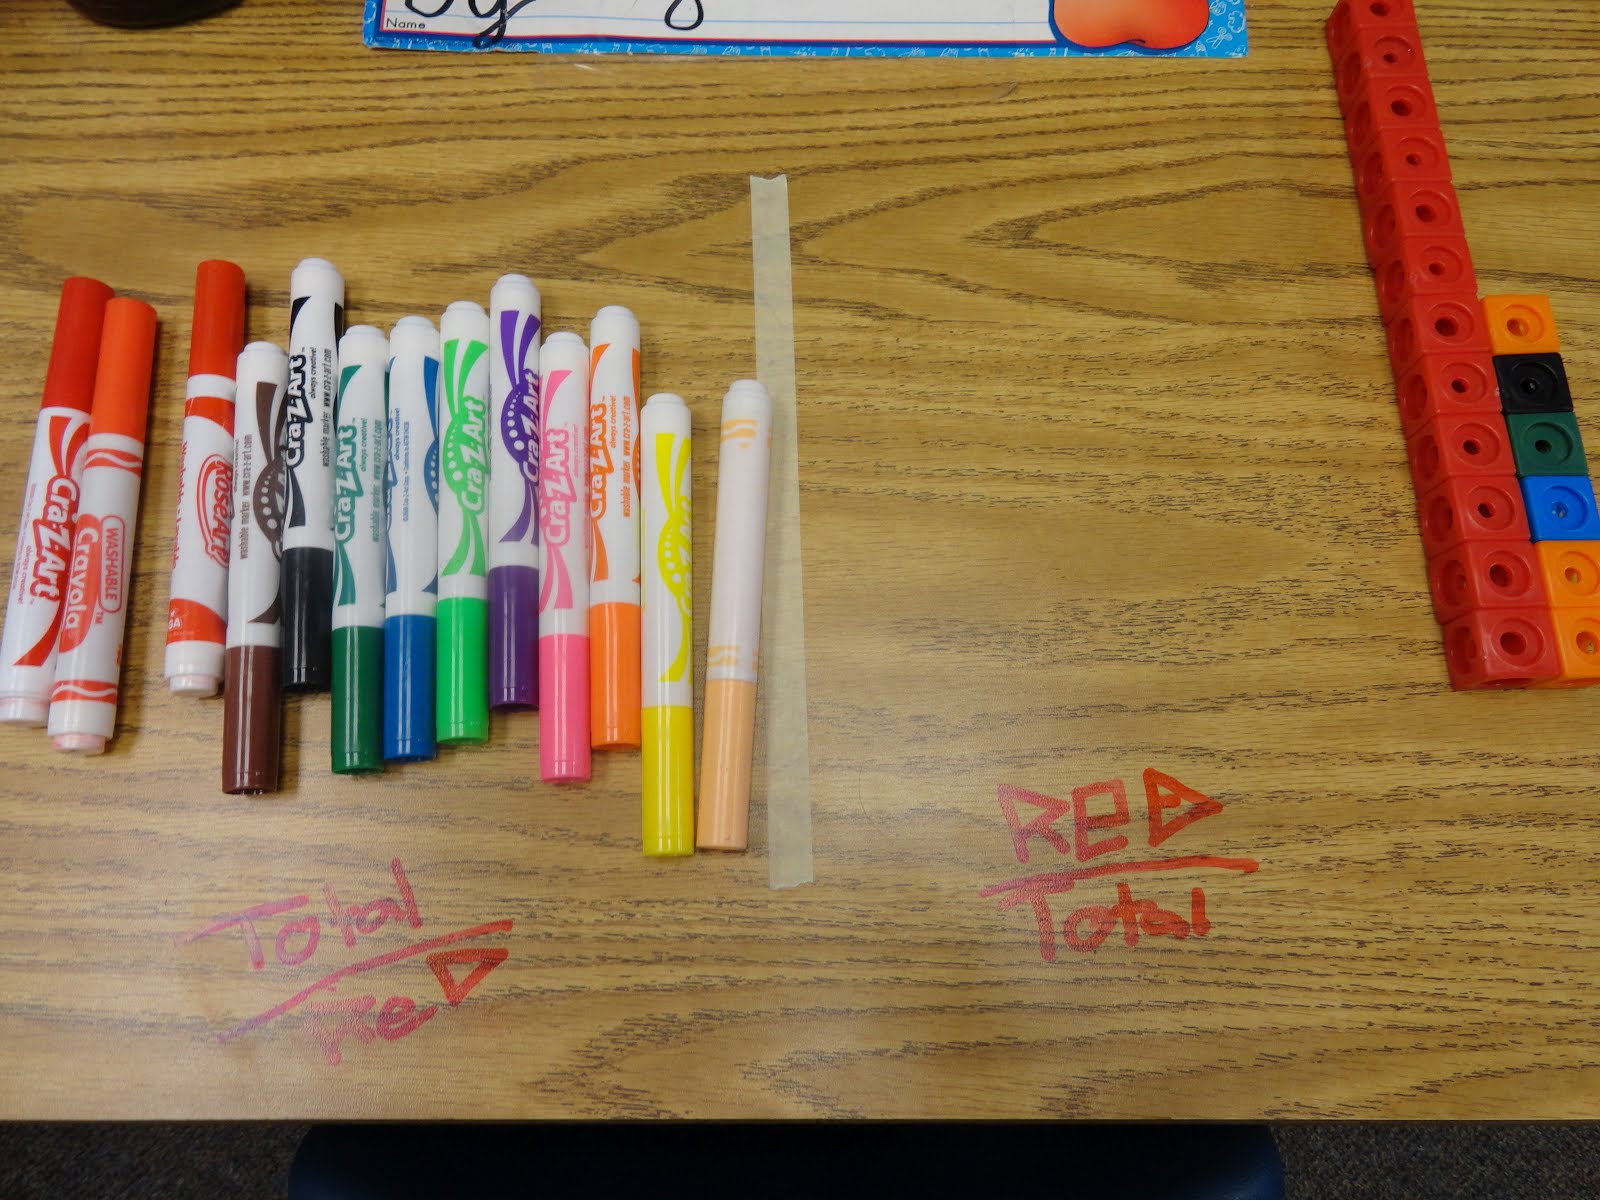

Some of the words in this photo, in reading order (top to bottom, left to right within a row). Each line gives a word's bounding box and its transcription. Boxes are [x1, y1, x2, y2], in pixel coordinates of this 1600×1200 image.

[385, 17, 426, 30] Name
[309, 347, 317, 376] creative!
[309, 377, 318, 399] always
[320, 437, 330, 467] washable
[240, 501, 250, 525] marker
[236, 527, 249, 560] washable
[65, 527, 99, 630] Crayola
[105, 527, 119, 601] WASHABLE
[173, 857, 424, 970] Total
[1000, 879, 1212, 961] Total
